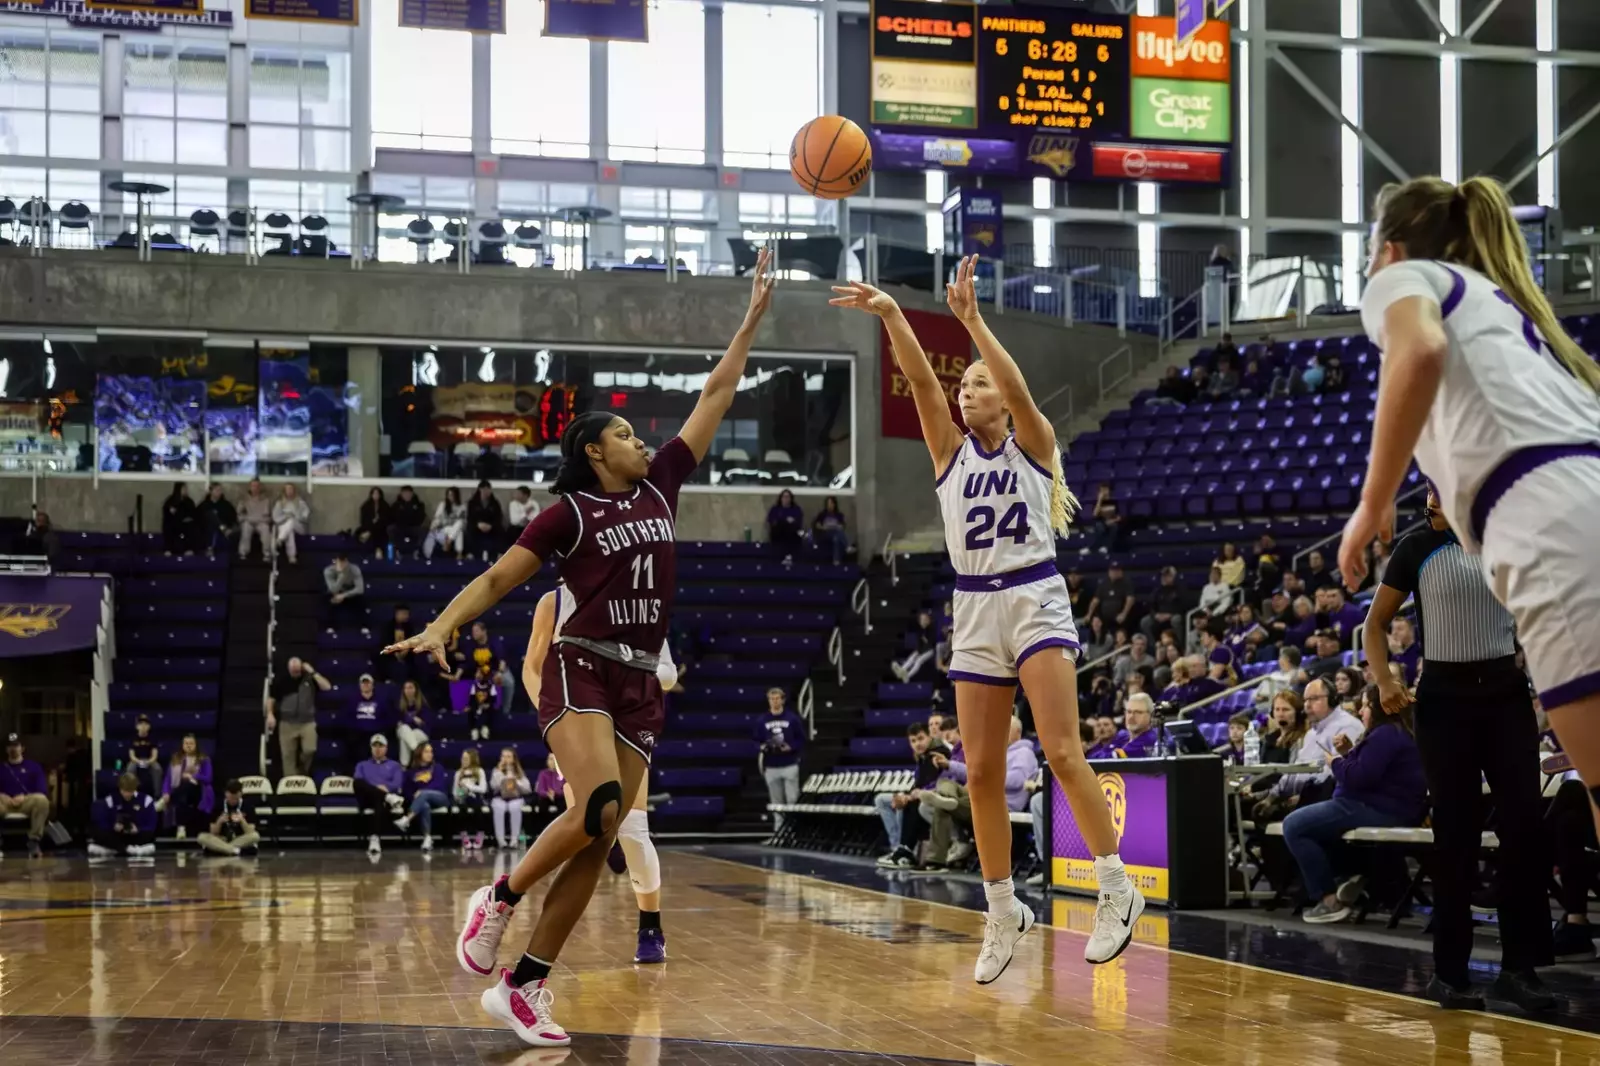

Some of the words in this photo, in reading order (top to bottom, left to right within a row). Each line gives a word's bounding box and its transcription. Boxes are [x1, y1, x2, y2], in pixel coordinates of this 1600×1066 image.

[877, 15, 972, 38] SCHEELS
[1028, 38, 1077, 62] 6:28
[1071, 67, 1080, 83] 1
[1095, 101, 1105, 116] 1
[1149, 88, 1213, 111] Great
[1155, 107, 1212, 133] Clips
[963, 469, 1018, 499] UNI
[965, 501, 1031, 551] 24
[631, 553, 654, 590] 11
